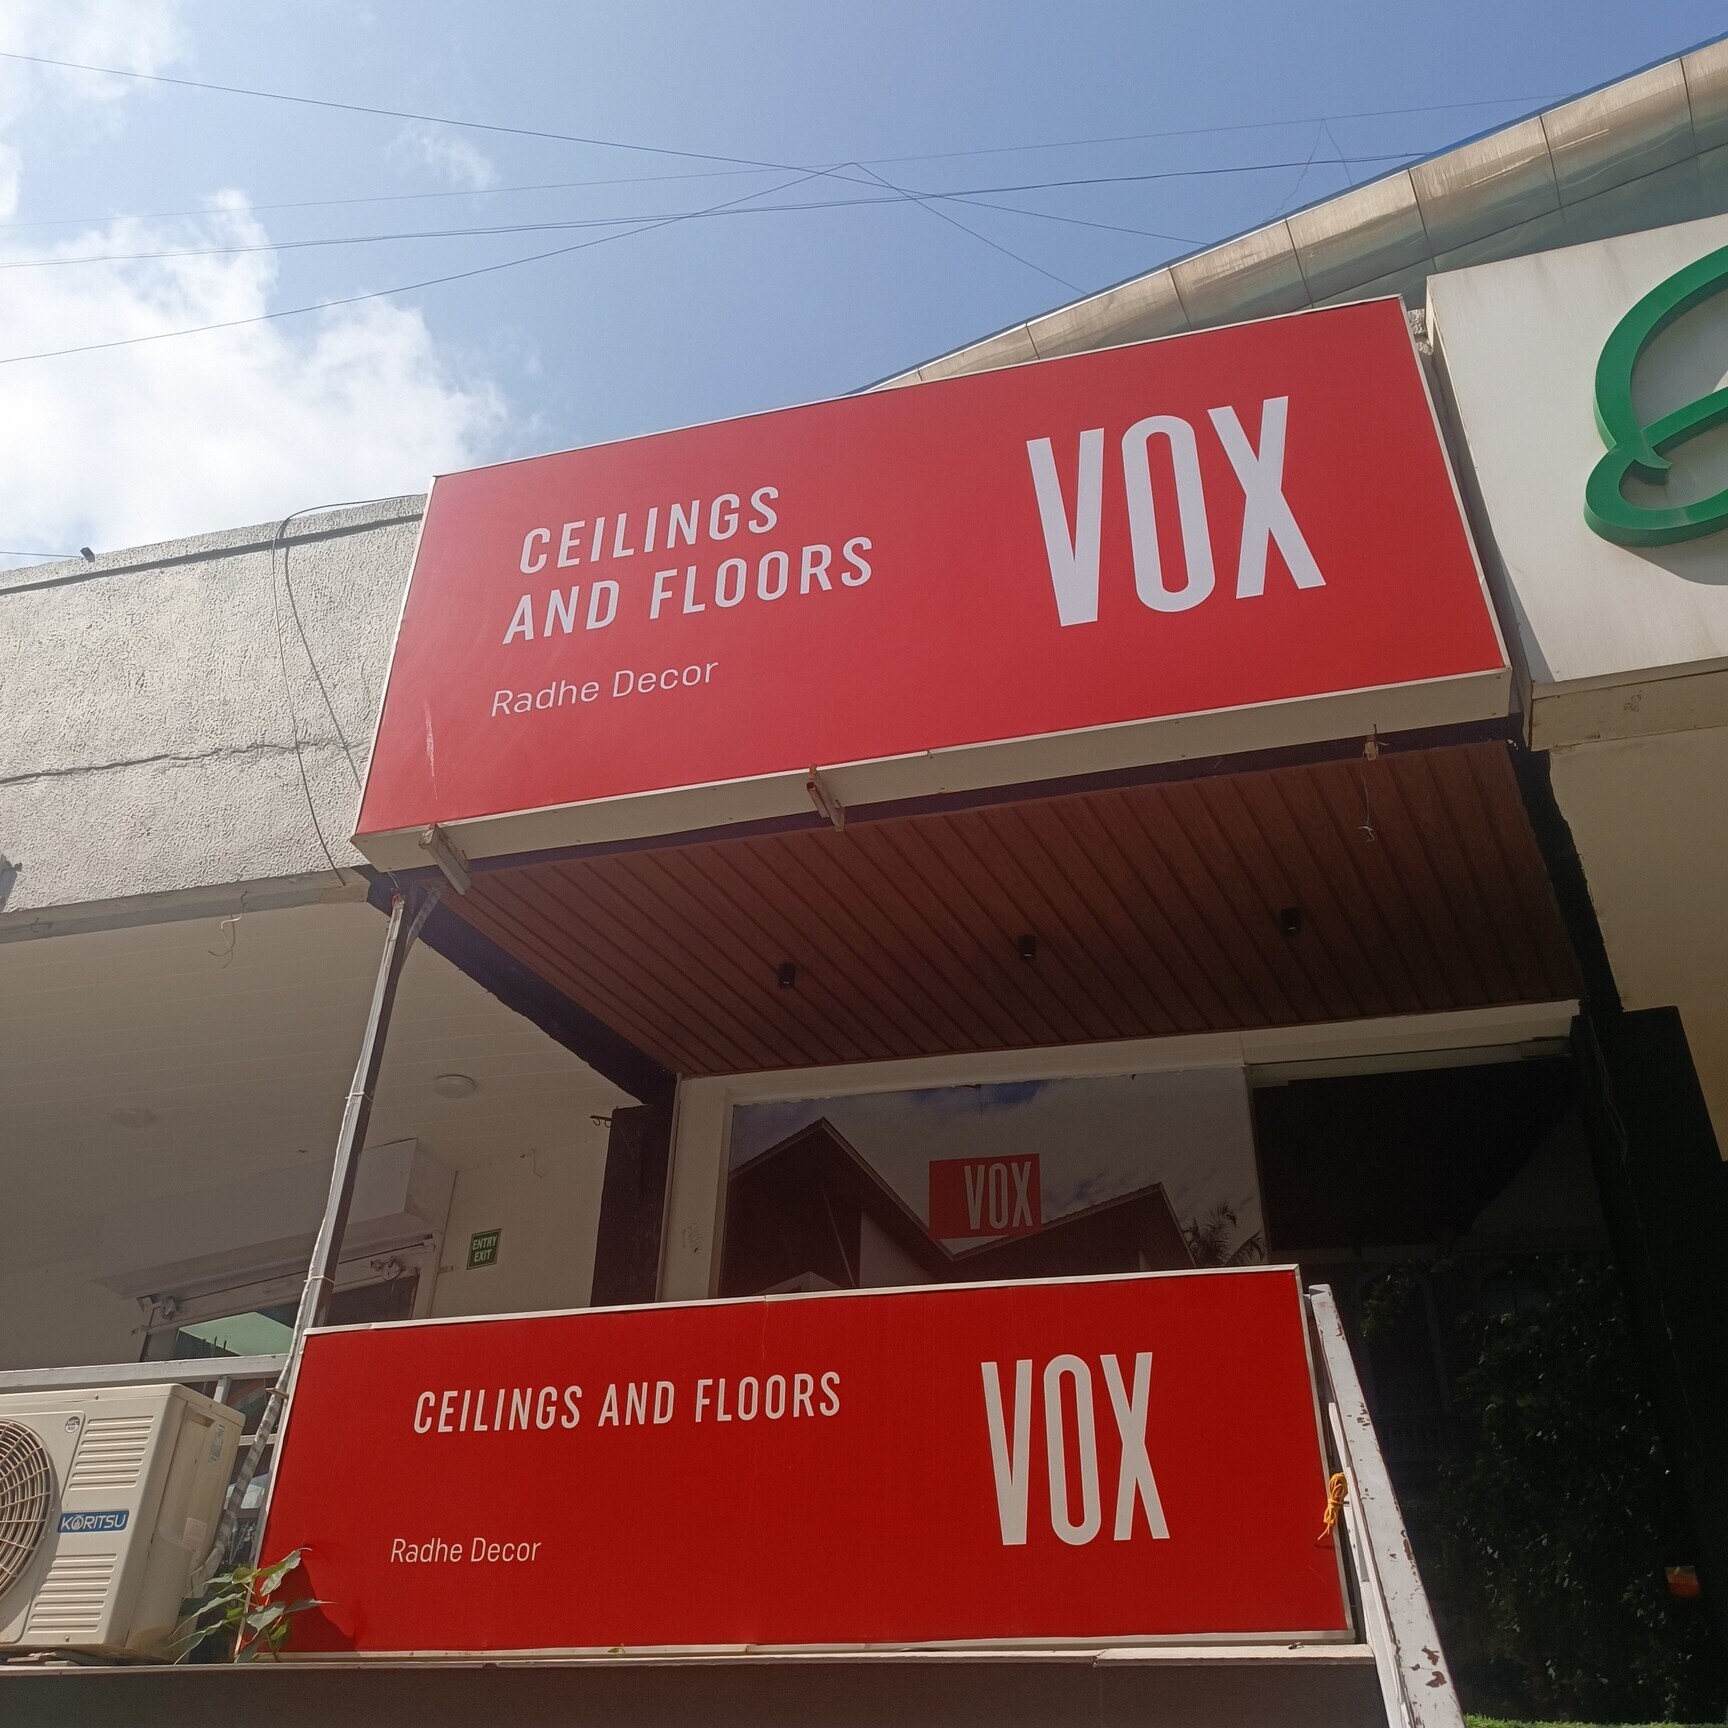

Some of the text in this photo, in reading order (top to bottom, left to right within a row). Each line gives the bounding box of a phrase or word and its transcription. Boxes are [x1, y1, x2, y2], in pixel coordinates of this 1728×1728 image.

[519, 486, 780, 574] CEILINGS
[1027, 396, 1326, 627] VOX
[502, 536, 873, 645] AND FLOORS
[490, 661, 720, 718] Radhe Decor
[964, 1161, 1034, 1230] VOX
[472, 1235, 498, 1250] ENTRY
[473, 1249, 492, 1263] EXIT
[413, 1371, 841, 1434] CEILINGS AND FLOORS
[980, 1351, 1171, 1546] VOX
[390, 1537, 542, 1563] Radhe Decor
